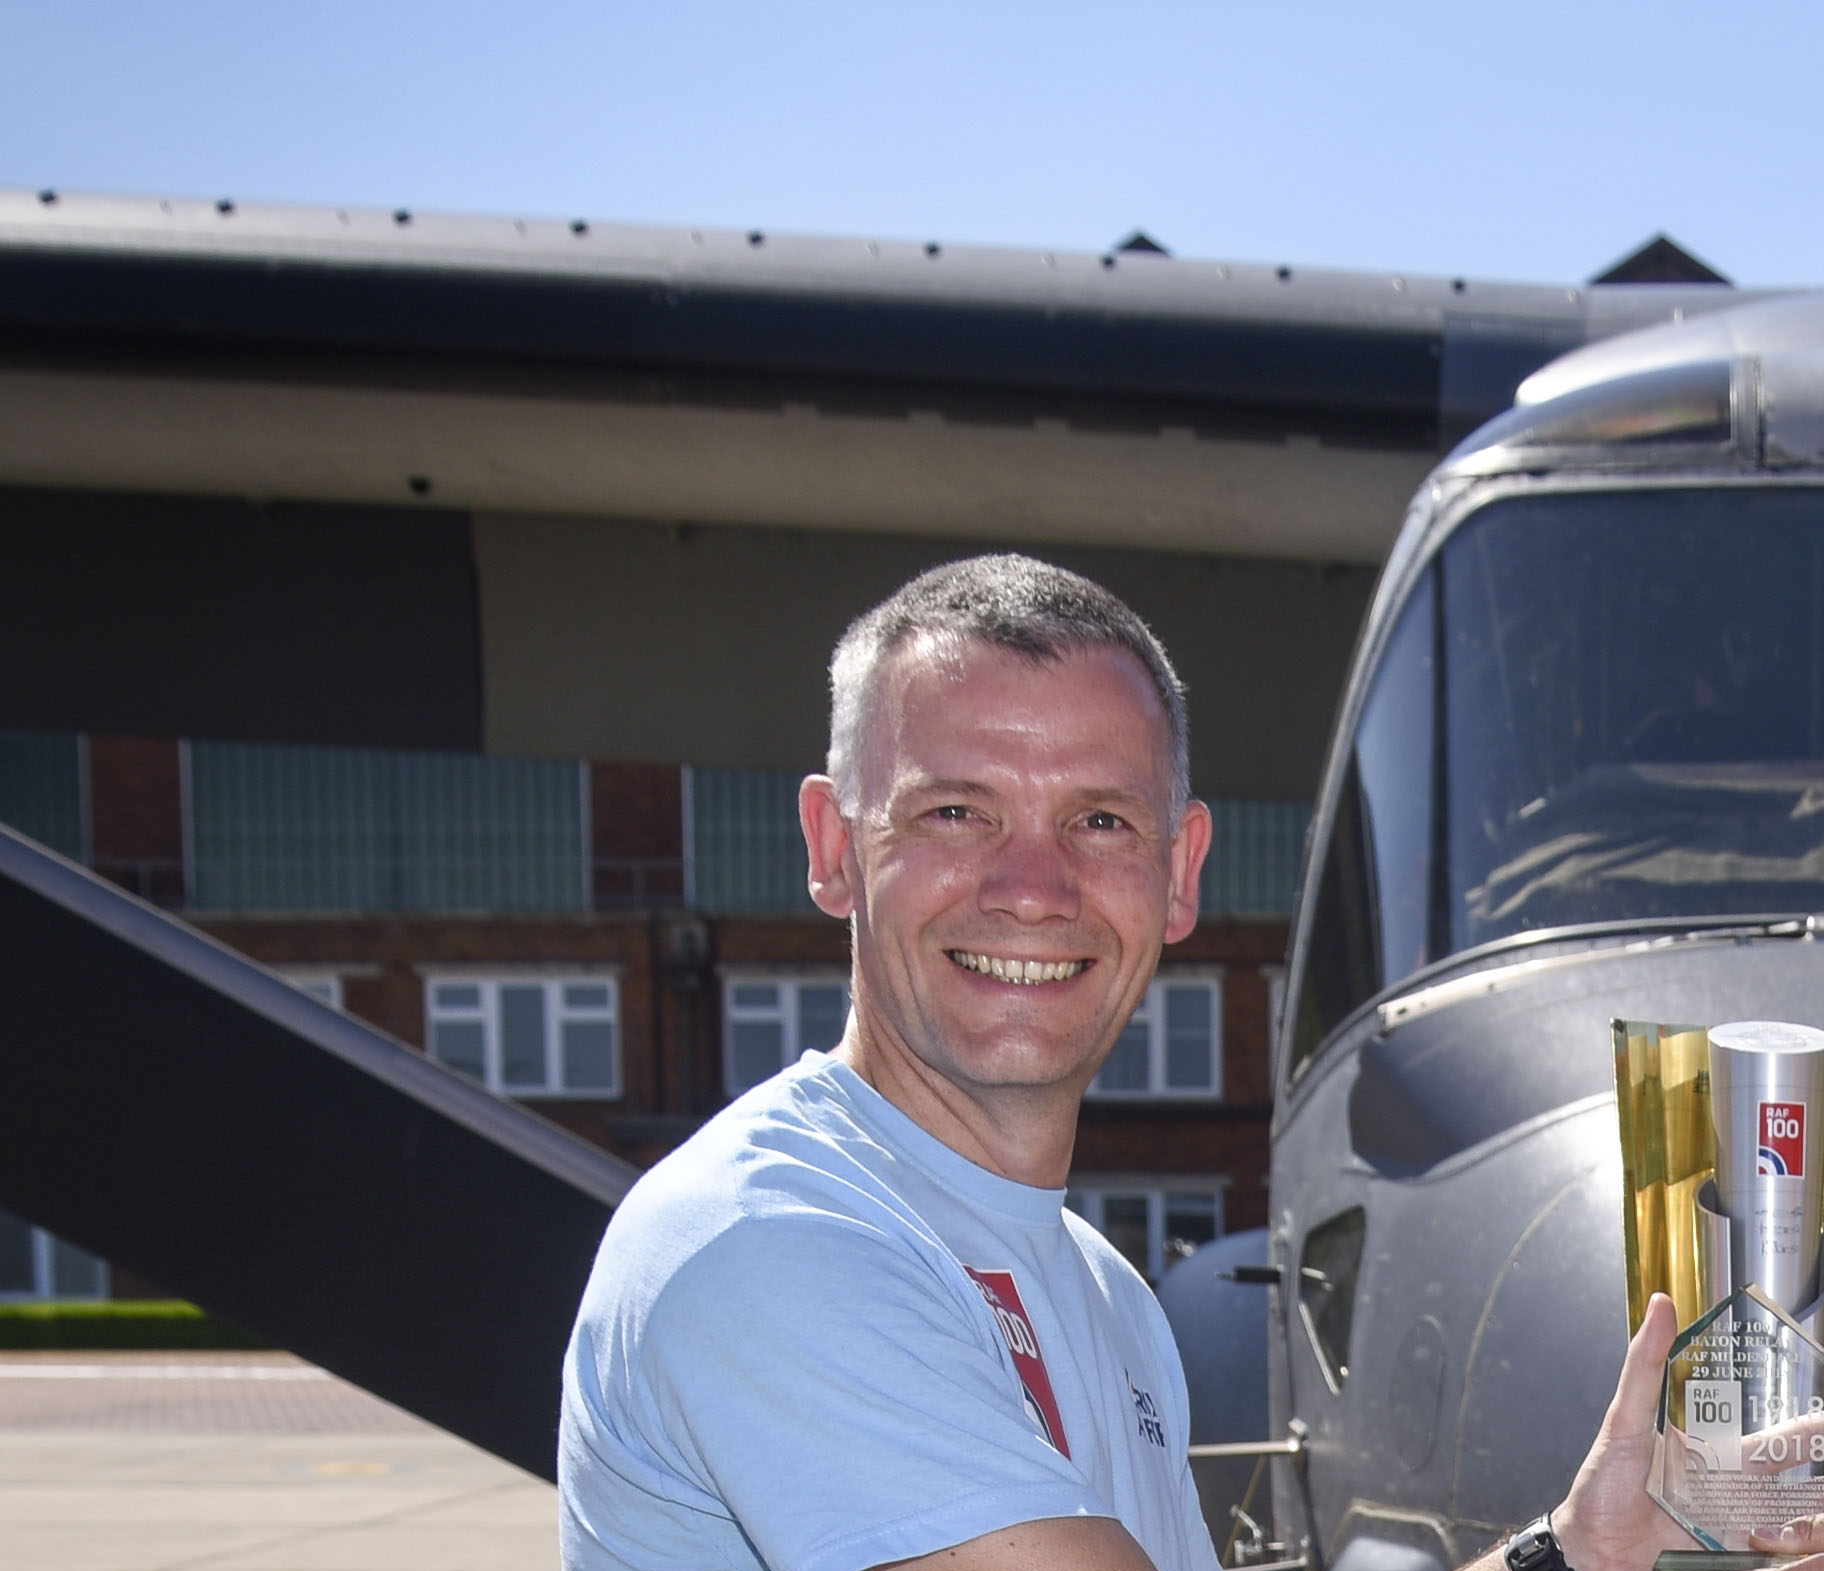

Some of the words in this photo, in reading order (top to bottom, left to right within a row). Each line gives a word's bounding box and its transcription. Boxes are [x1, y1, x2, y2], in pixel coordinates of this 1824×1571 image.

[1766, 1108, 1789, 1118] RAF
[1766, 1119, 1799, 1138] 100
[1712, 1321, 1742, 1333] RAF
[1691, 1335, 1741, 1347] BATON
[1681, 1351, 1708, 1362] RAF
[1692, 1366, 1710, 1378] 29
[1712, 1367, 1754, 1378] JUNE
[1693, 1389, 1720, 1399] RAF
[1694, 1402, 1732, 1423] 100
[1749, 1395, 1824, 1423] 1918
